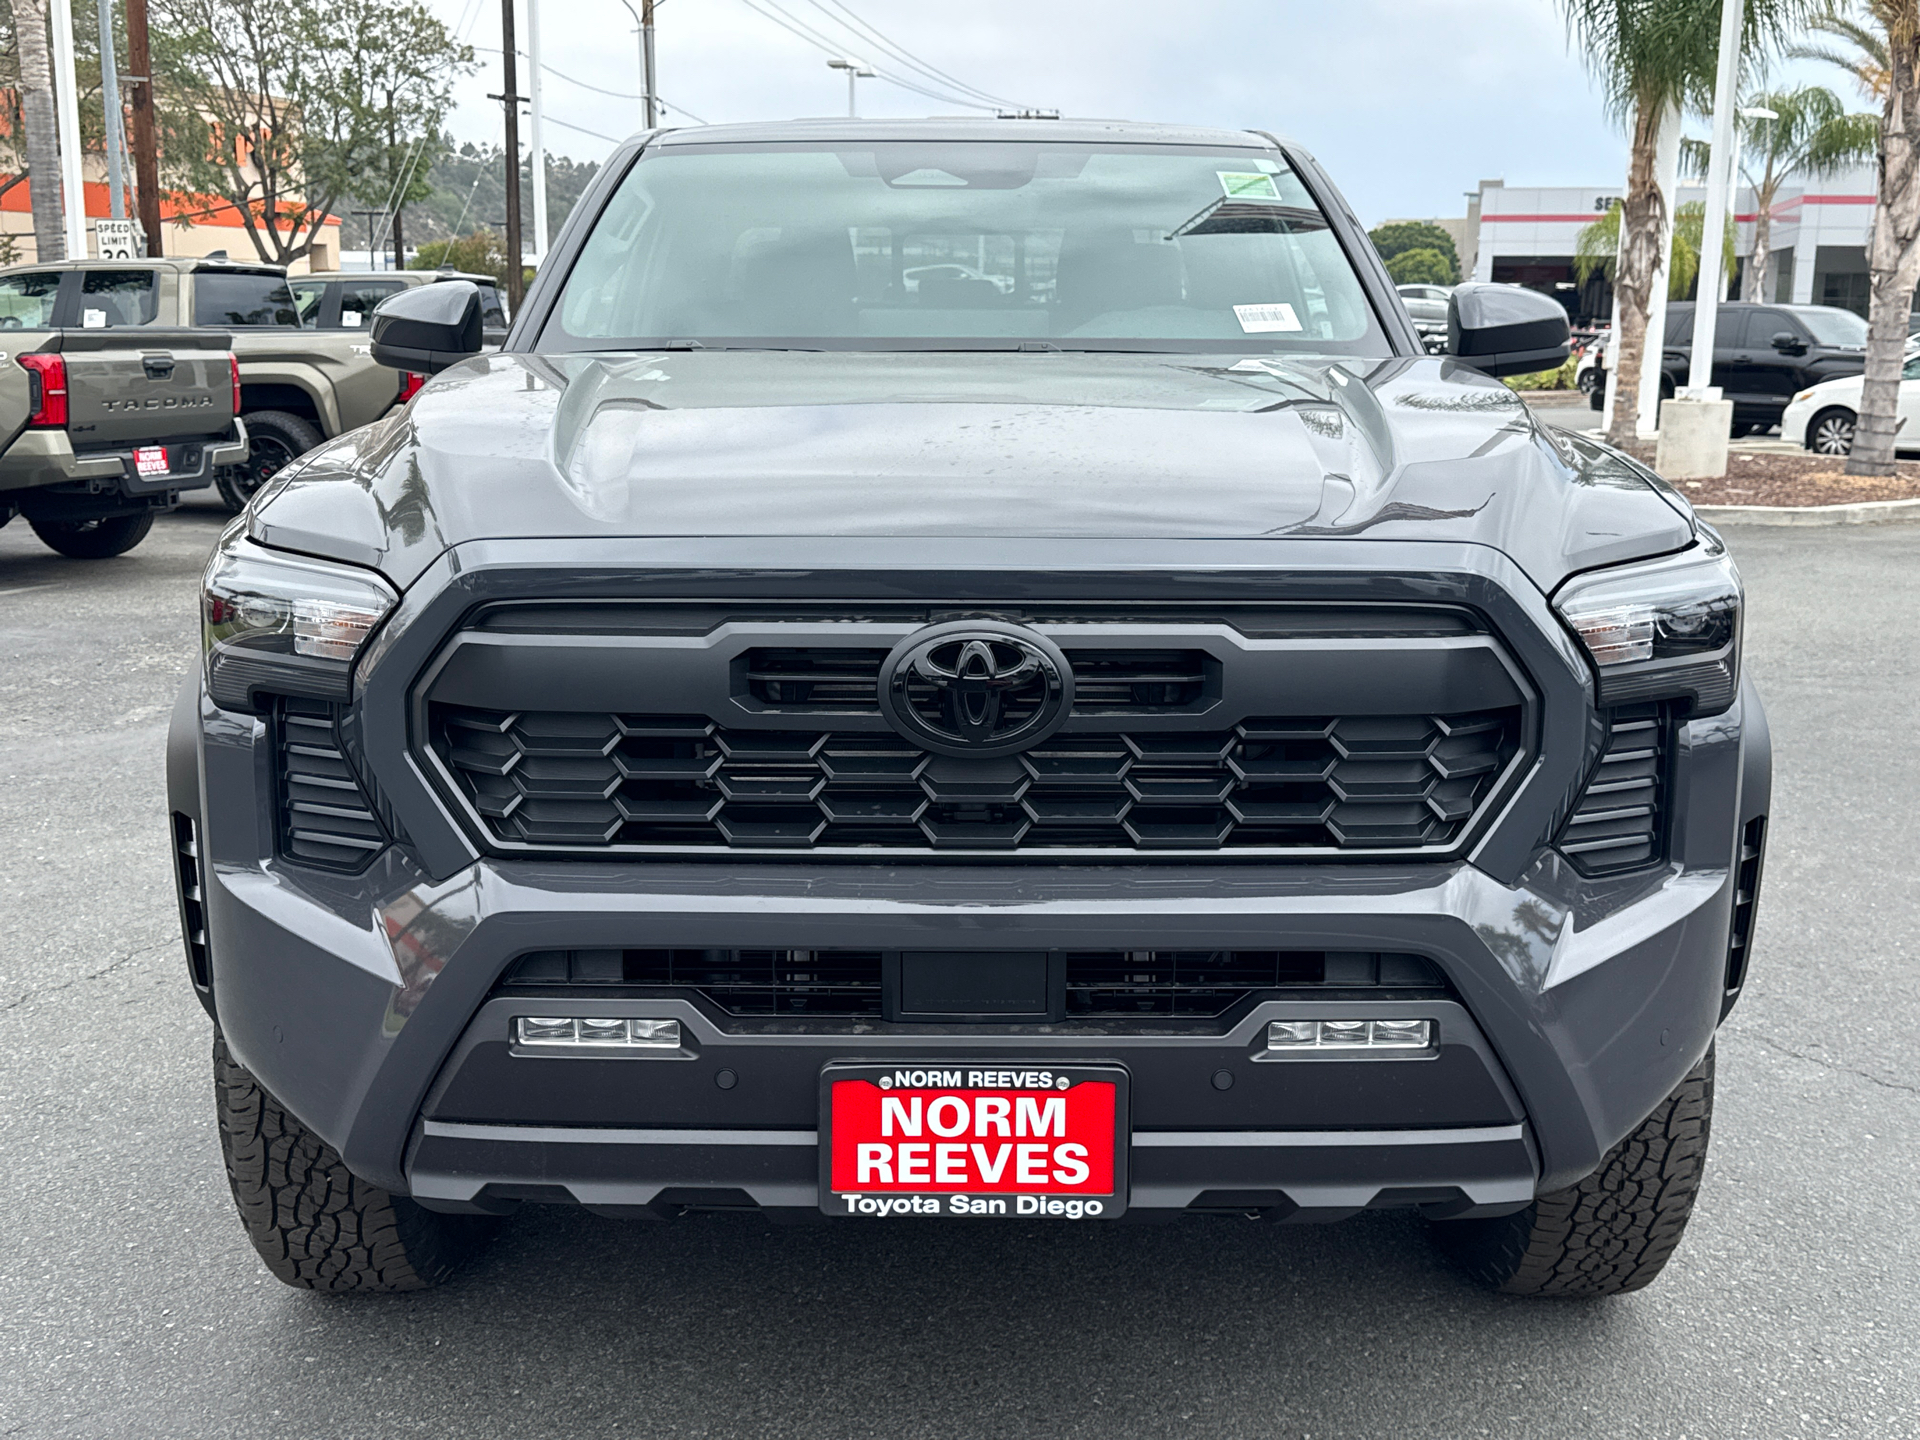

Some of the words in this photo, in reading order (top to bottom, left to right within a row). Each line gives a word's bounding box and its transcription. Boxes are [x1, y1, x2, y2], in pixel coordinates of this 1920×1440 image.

[1595, 197, 1624, 211] SE
[98, 223, 129, 233] SPEED
[101, 236, 127, 245] LIMIT
[101, 396, 214, 412] TACOMA
[895, 1070, 961, 1087] NORM
[968, 1071, 1053, 1088] REEVES
[881, 1096, 1066, 1138] NORM
[857, 1142, 1090, 1185] REEVES
[841, 1194, 940, 1217] Toyota
[949, 1195, 1006, 1215] San
[1016, 1195, 1104, 1219] Diego
